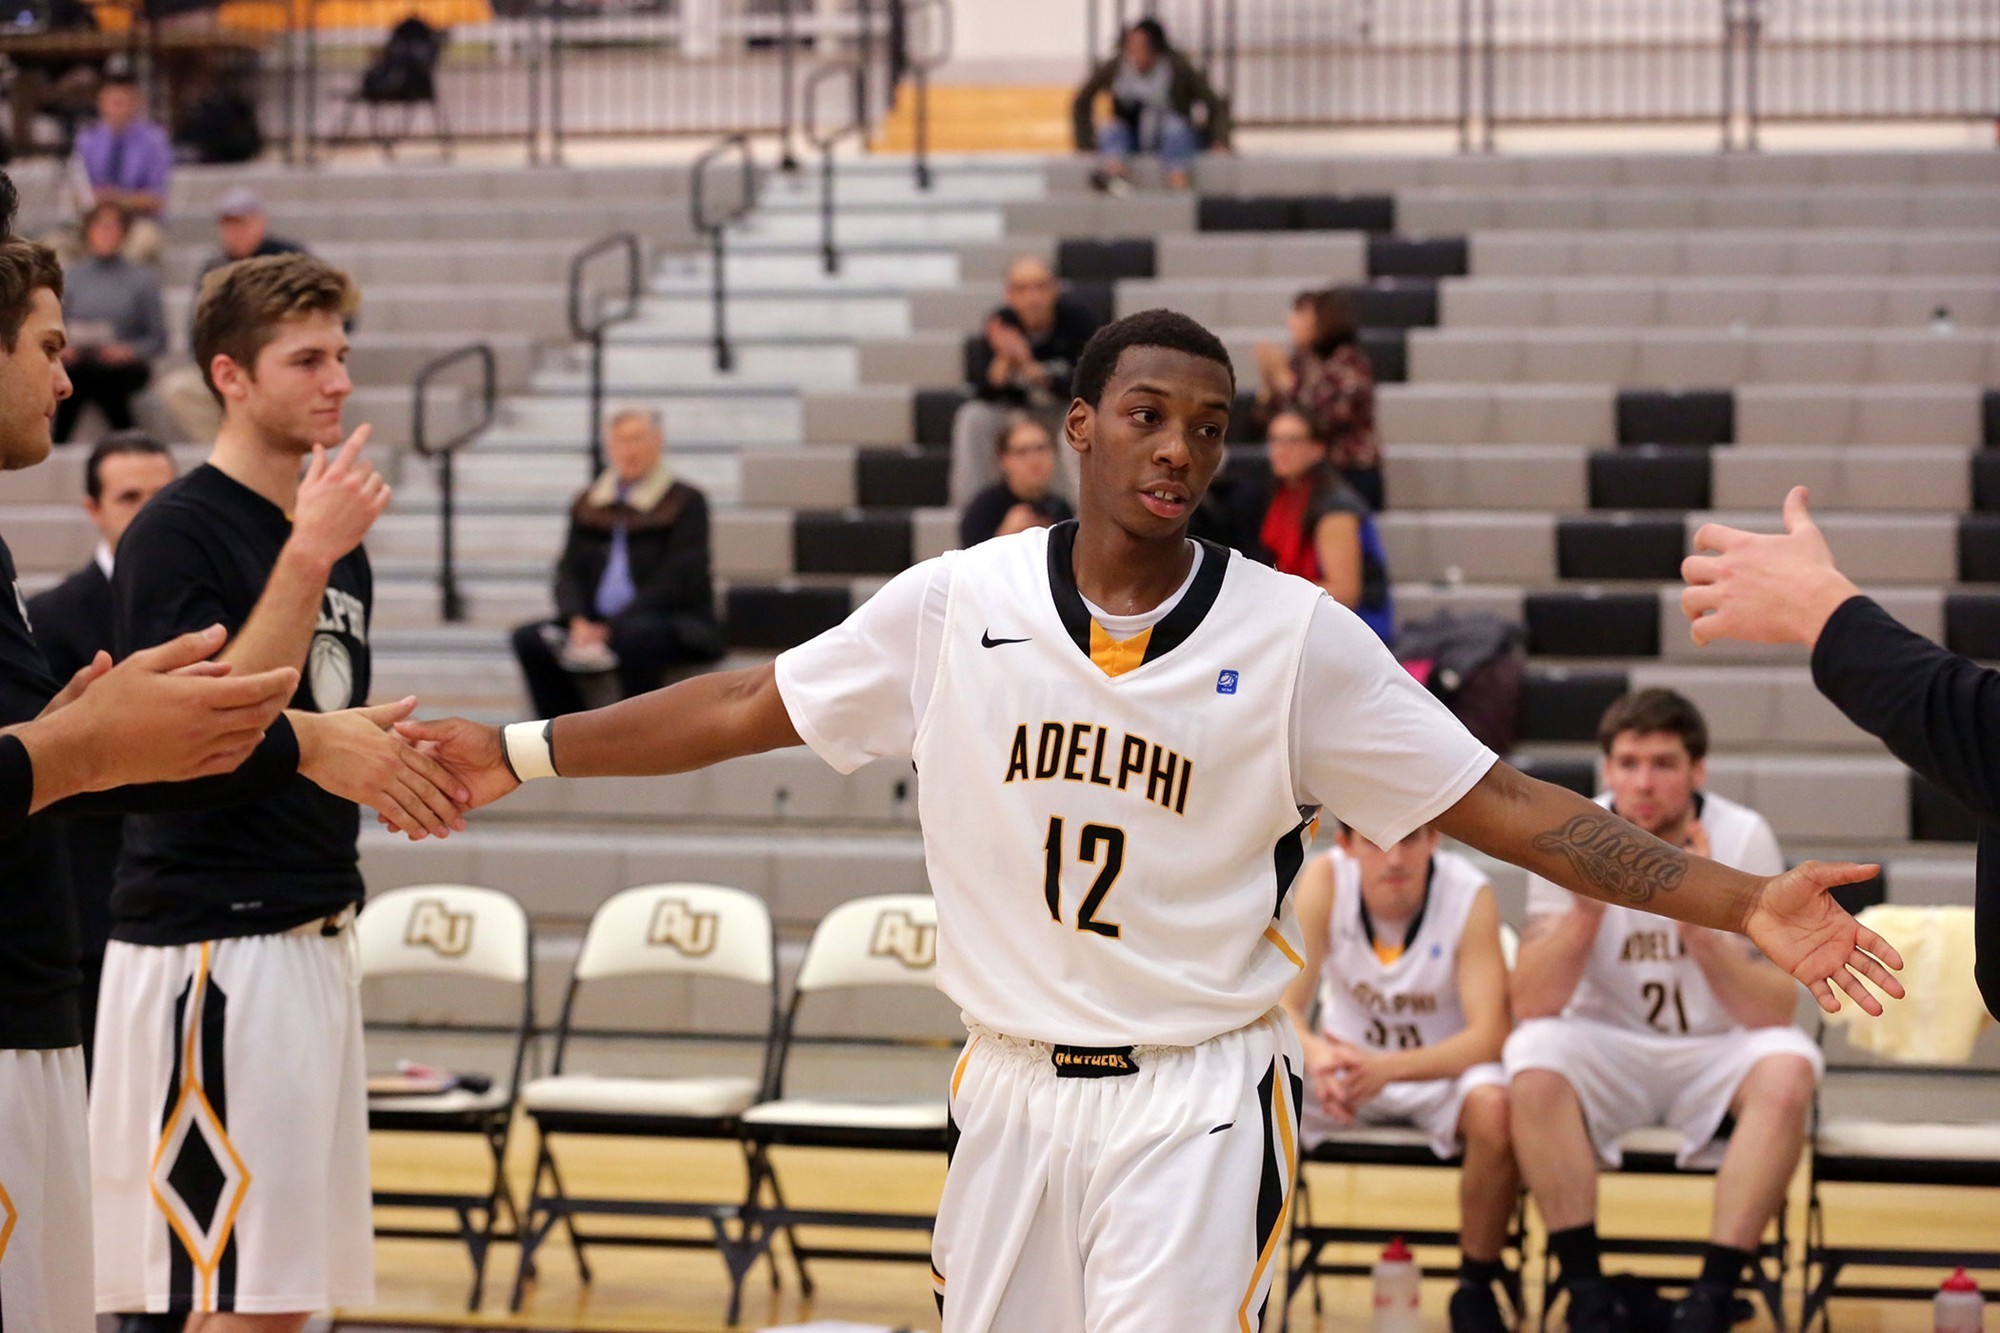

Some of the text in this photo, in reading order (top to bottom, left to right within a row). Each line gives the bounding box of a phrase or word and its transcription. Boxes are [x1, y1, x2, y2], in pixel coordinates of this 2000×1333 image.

[1003, 720, 1194, 817] ADELPHI
[1042, 814, 1127, 940] 12
[405, 899, 474, 957] AU
[647, 899, 717, 957] AU
[869, 911, 937, 968] AU
[1621, 932, 1685, 961] ADEL
[1642, 981, 1688, 1032] 21
